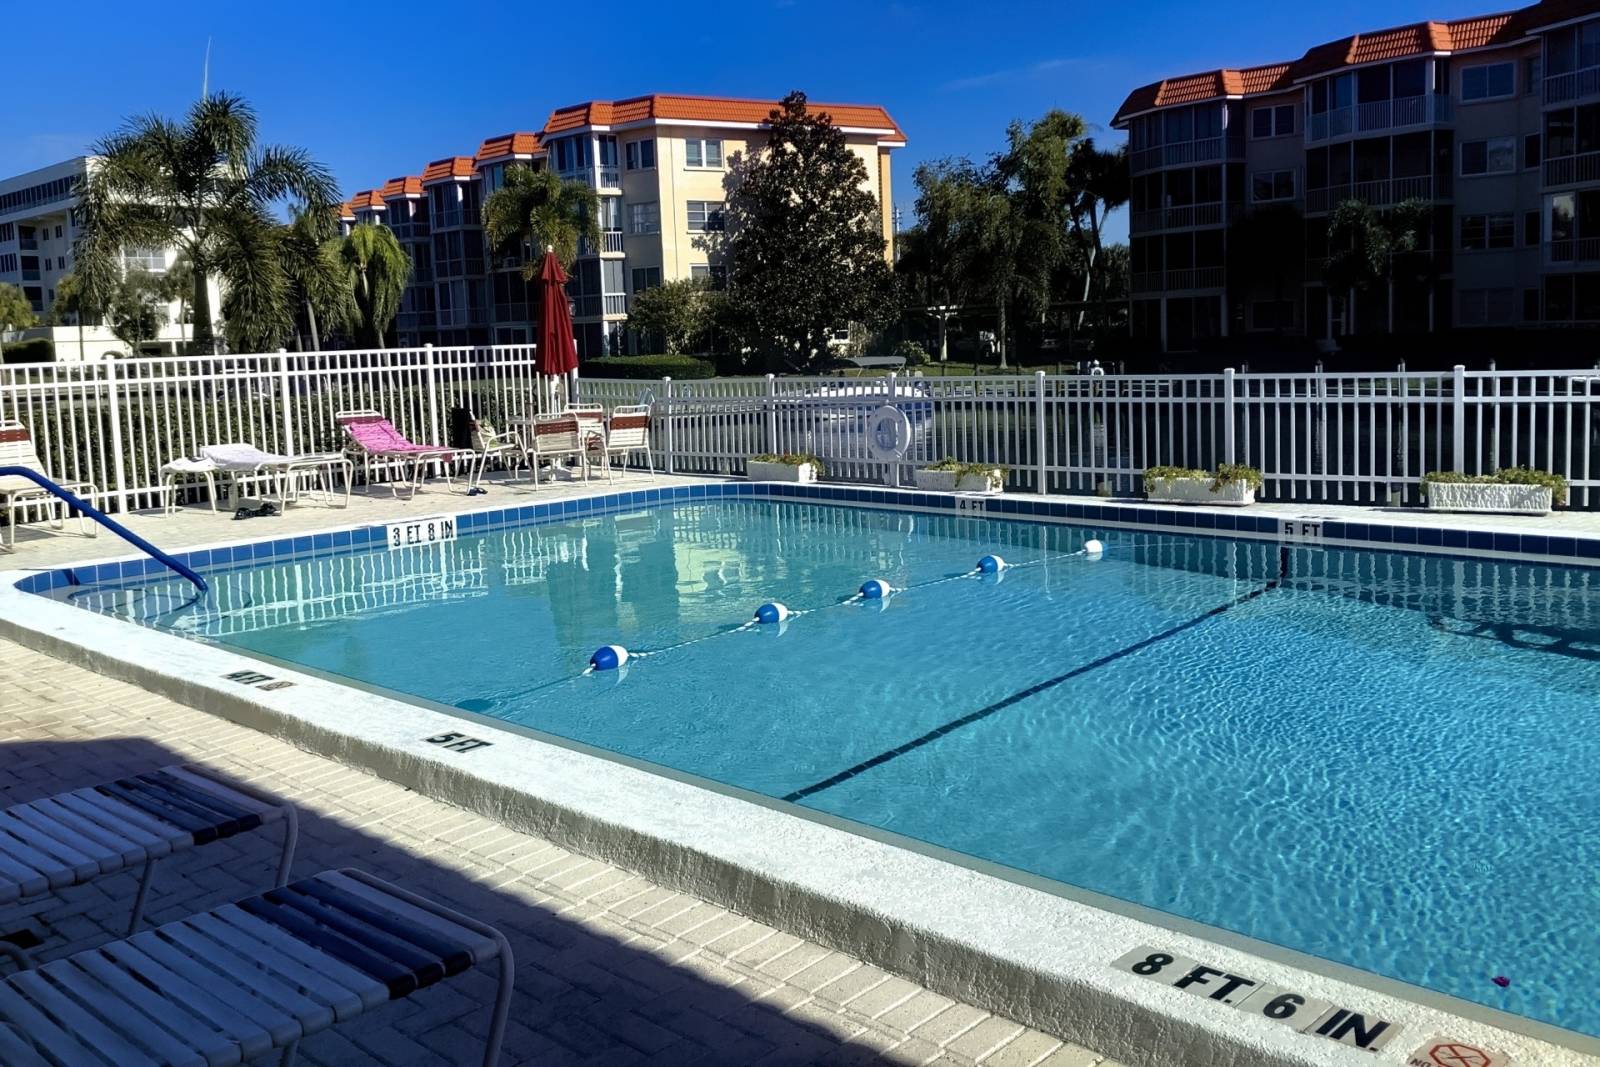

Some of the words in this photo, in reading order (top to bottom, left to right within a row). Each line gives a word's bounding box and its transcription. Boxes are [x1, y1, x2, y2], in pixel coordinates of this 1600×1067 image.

[960, 499, 967, 510] 4
[971, 500, 985, 511] FT
[1284, 522, 1294, 535] 5
[1301, 523, 1321, 537] FT
[1131, 953, 1174, 976] 8
[1262, 993, 1306, 1019] 6
